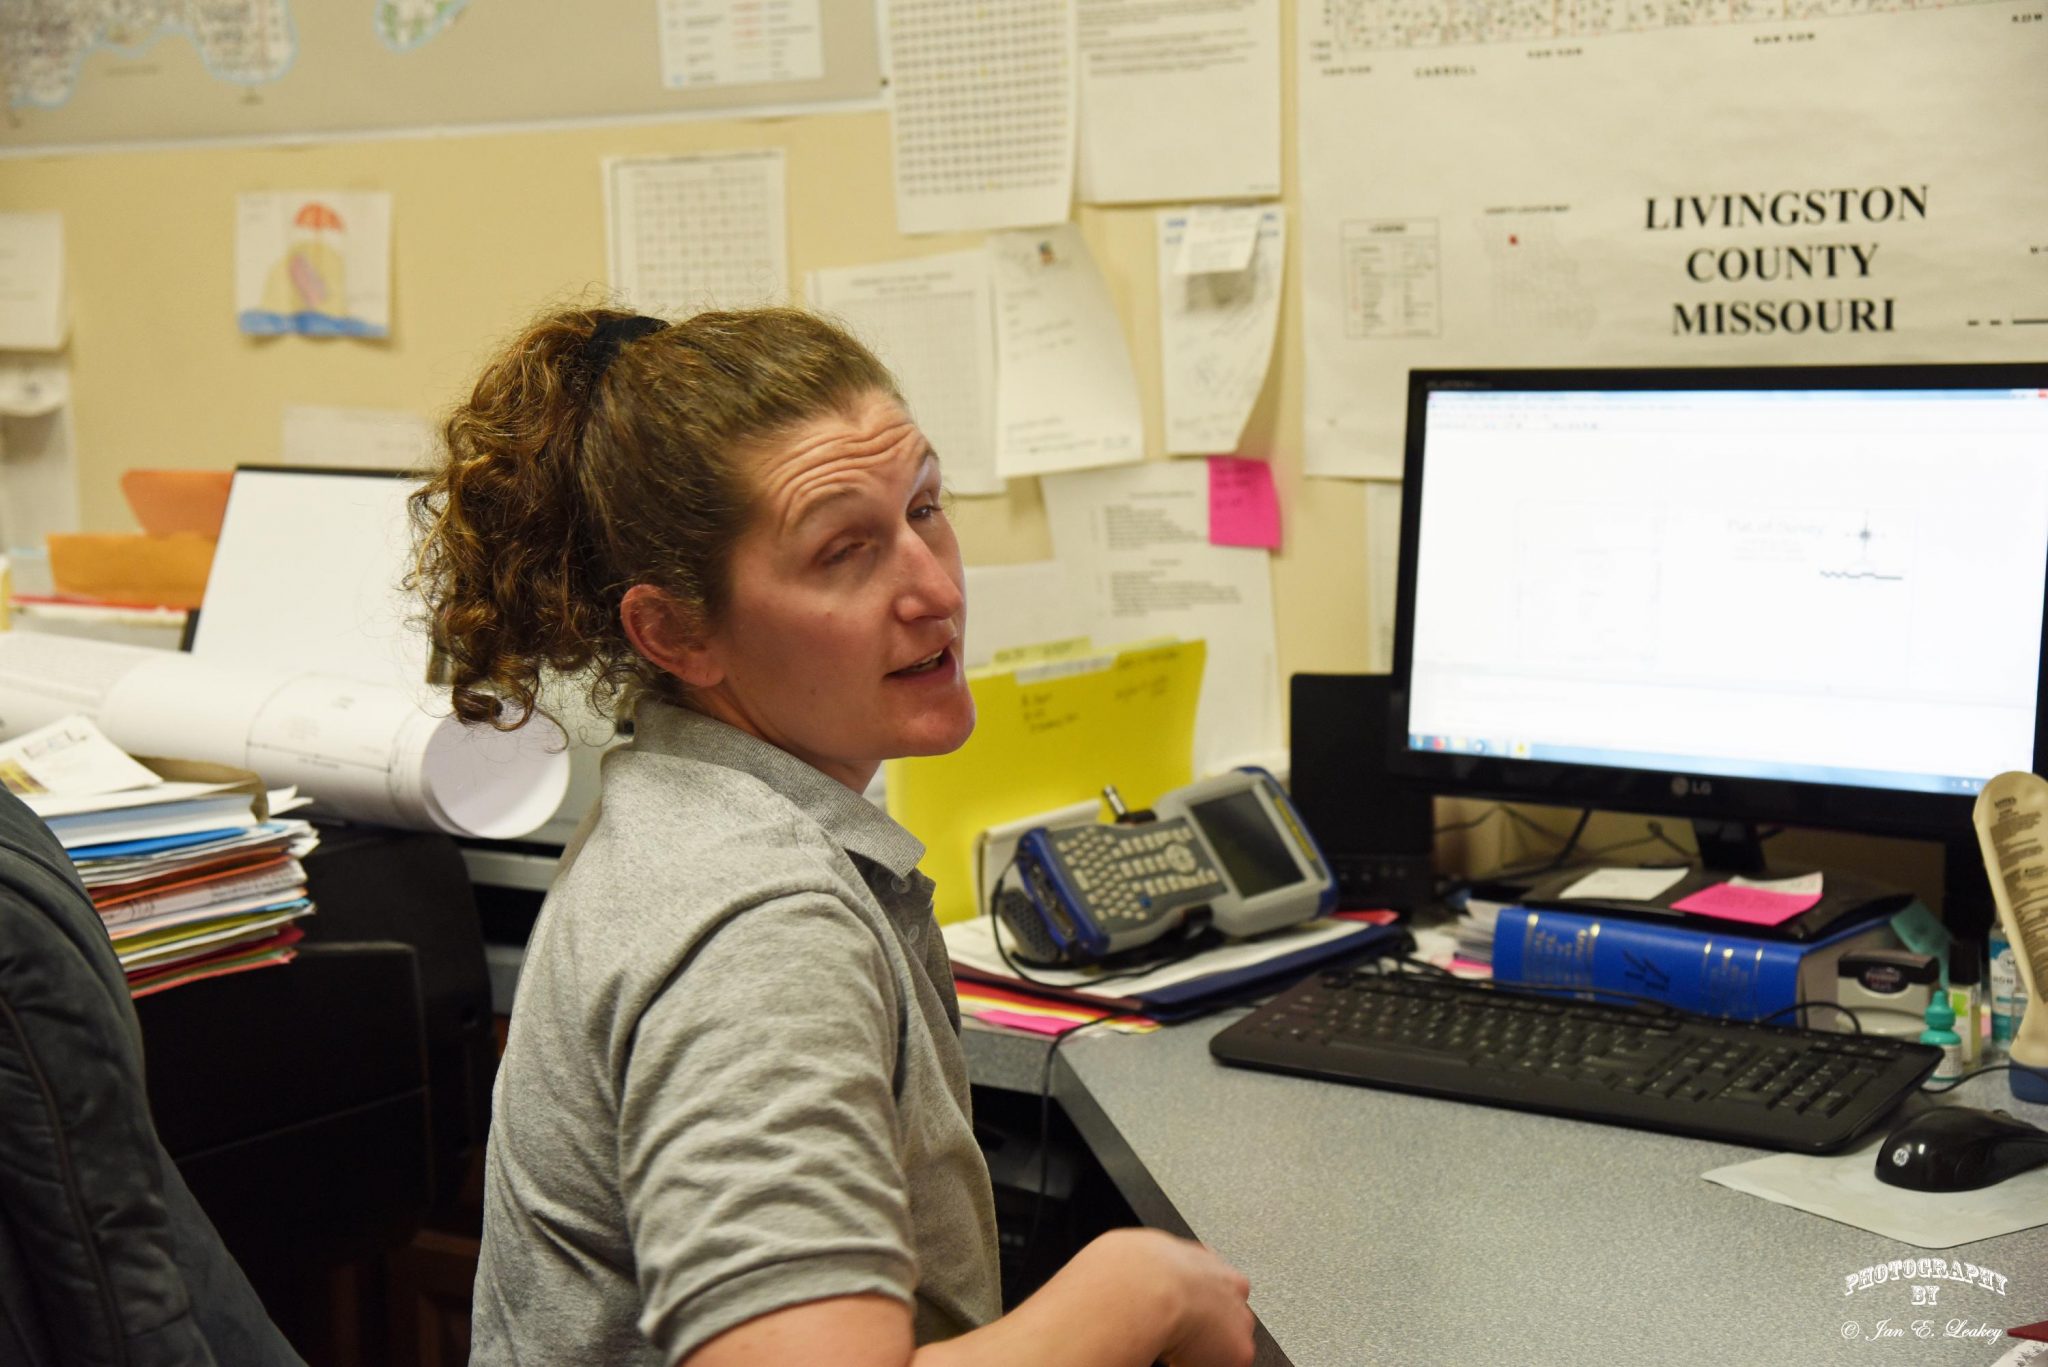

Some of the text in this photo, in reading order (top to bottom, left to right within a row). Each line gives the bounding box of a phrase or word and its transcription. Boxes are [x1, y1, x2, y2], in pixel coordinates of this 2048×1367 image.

[1645, 184, 1929, 230] LIVINGSTON
[1686, 243, 1879, 283] COUNTY
[1672, 298, 1896, 336] MISSOURI
